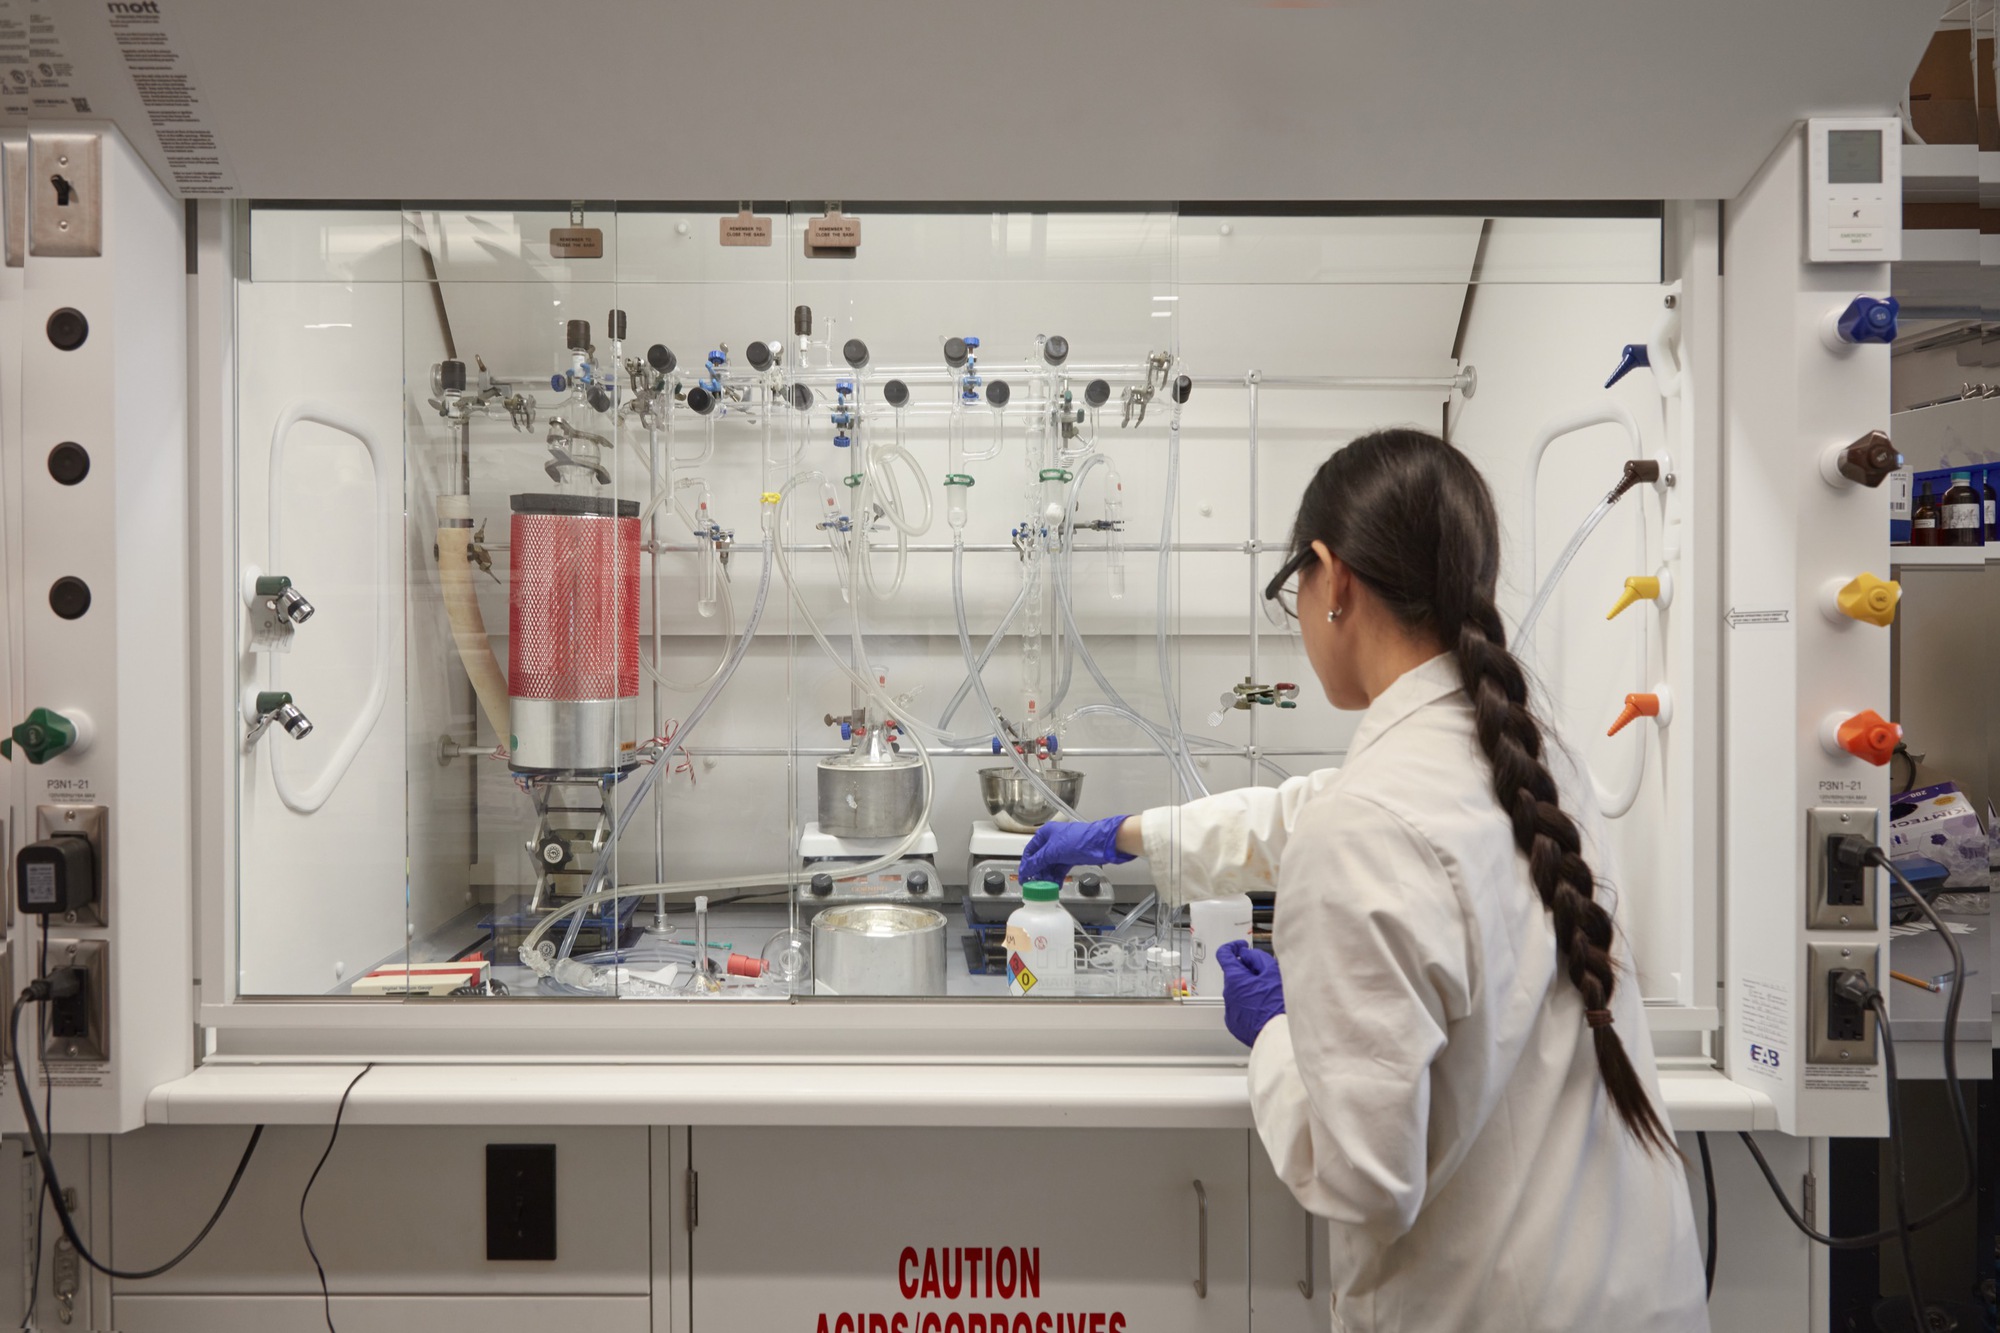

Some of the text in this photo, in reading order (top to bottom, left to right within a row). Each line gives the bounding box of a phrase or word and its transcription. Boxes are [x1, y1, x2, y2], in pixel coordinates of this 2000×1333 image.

[107, 1, 160, 14] mott
[47, 779, 89, 789] P3N1-21
[1819, 781, 1862, 790] P3N1-21
[1012, 957, 1019, 971] 3
[1021, 972, 1030, 986] 0
[898, 1246, 1040, 1300] CAUTION
